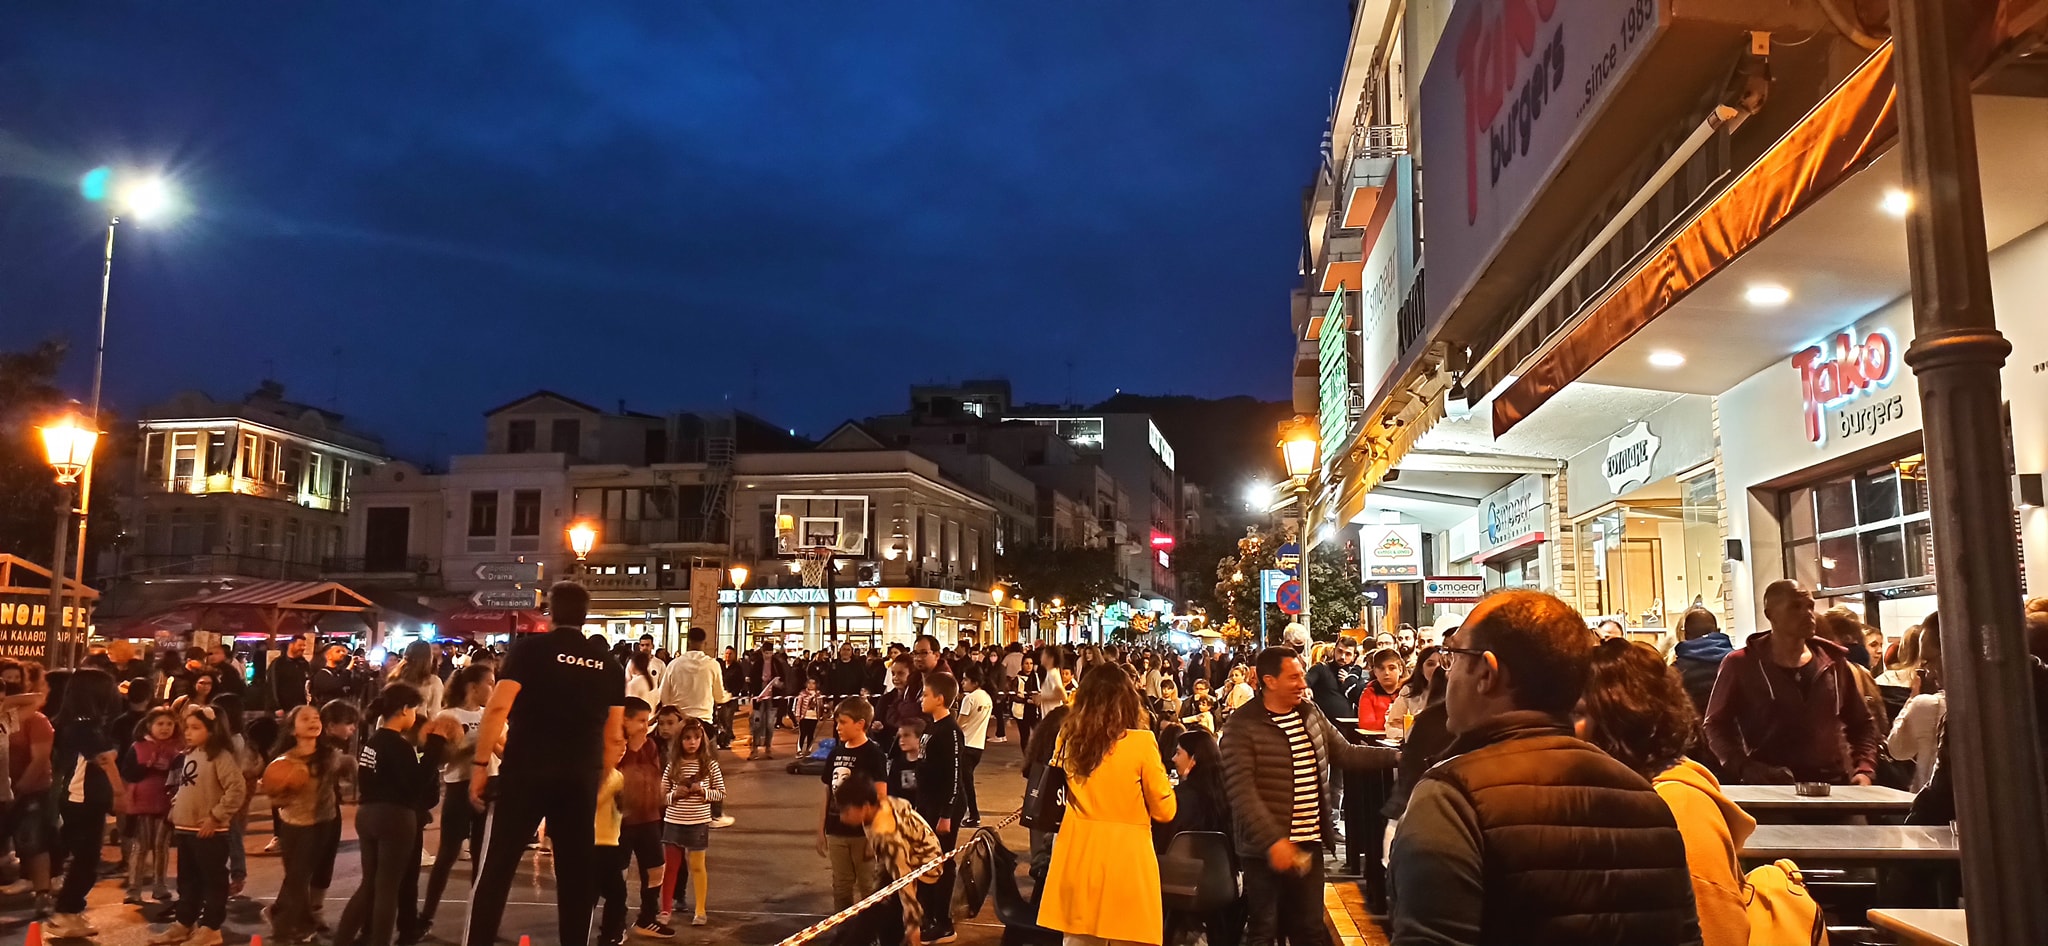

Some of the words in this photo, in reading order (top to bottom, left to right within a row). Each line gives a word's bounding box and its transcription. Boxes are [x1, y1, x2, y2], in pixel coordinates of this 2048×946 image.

[1620, 0, 1653, 52] 1985
[1490, 22, 1565, 188] burgers
[1791, 332, 1892, 442] Tako
[1839, 395, 1904, 438] burgers
[7, 645, 46, 657] ΚΑΒΑΛΑΣ
[556, 653, 604, 670] COACH
